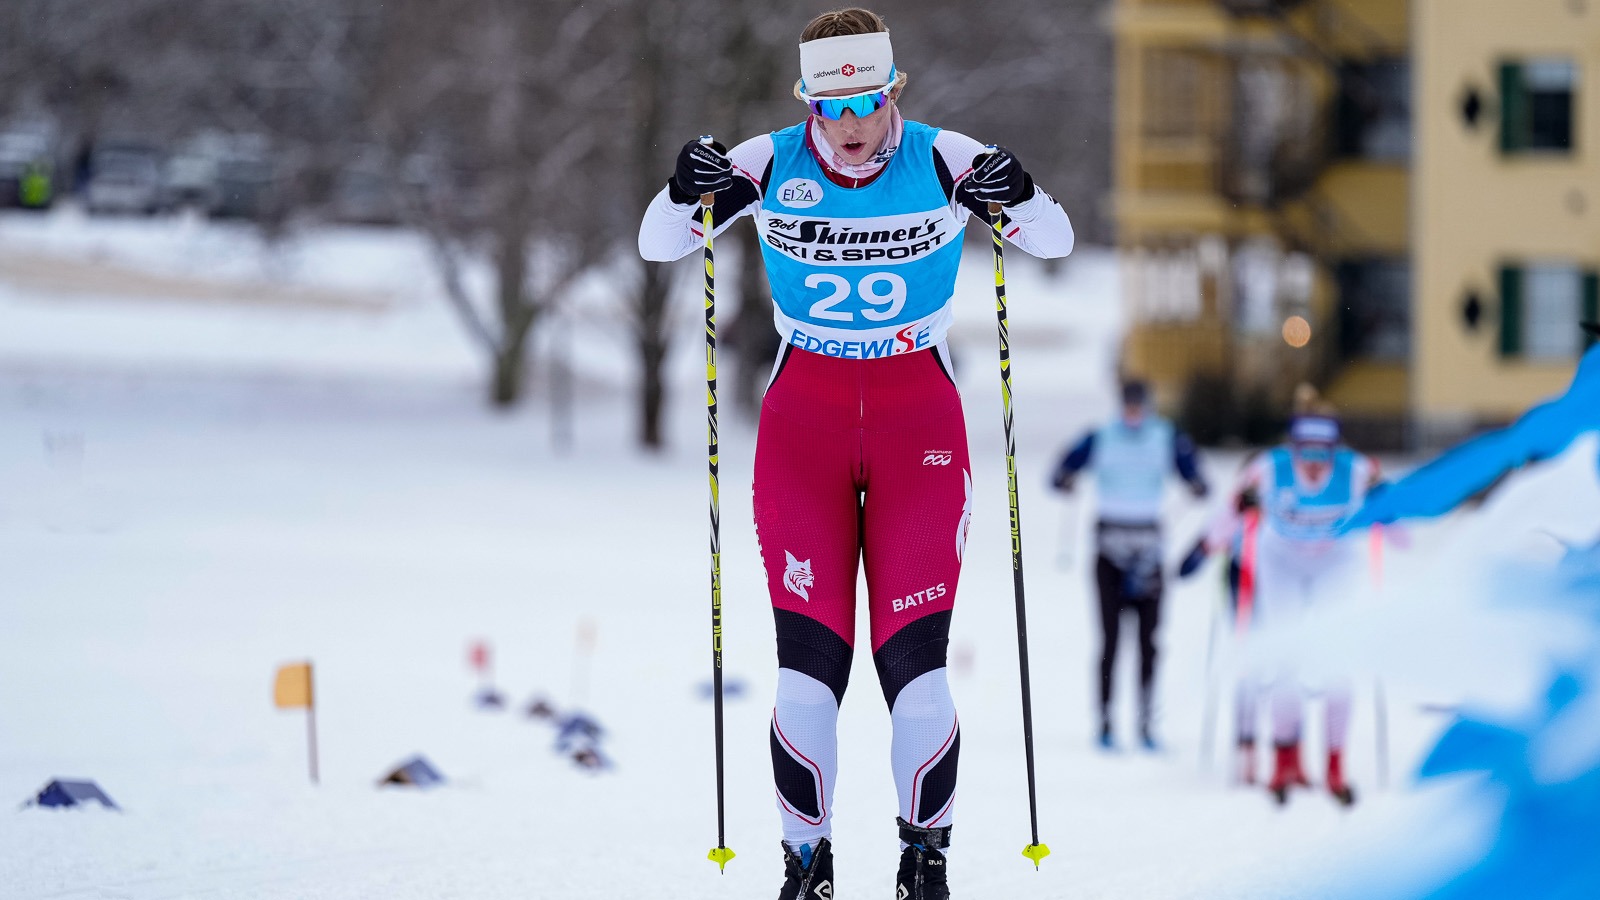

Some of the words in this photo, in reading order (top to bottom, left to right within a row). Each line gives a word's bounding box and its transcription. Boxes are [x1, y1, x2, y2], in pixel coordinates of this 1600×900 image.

[813, 68, 840, 79] caldwell
[856, 65, 875, 73] sport
[768, 218, 799, 231] Bob
[770, 218, 944, 245] Skinner's
[767, 234, 807, 259] SKI
[813, 249, 837, 261] &
[841, 231, 946, 261] SPORT
[804, 271, 907, 322] 29
[790, 322, 930, 360] EDGEWISE
[892, 582, 947, 613] BATES
